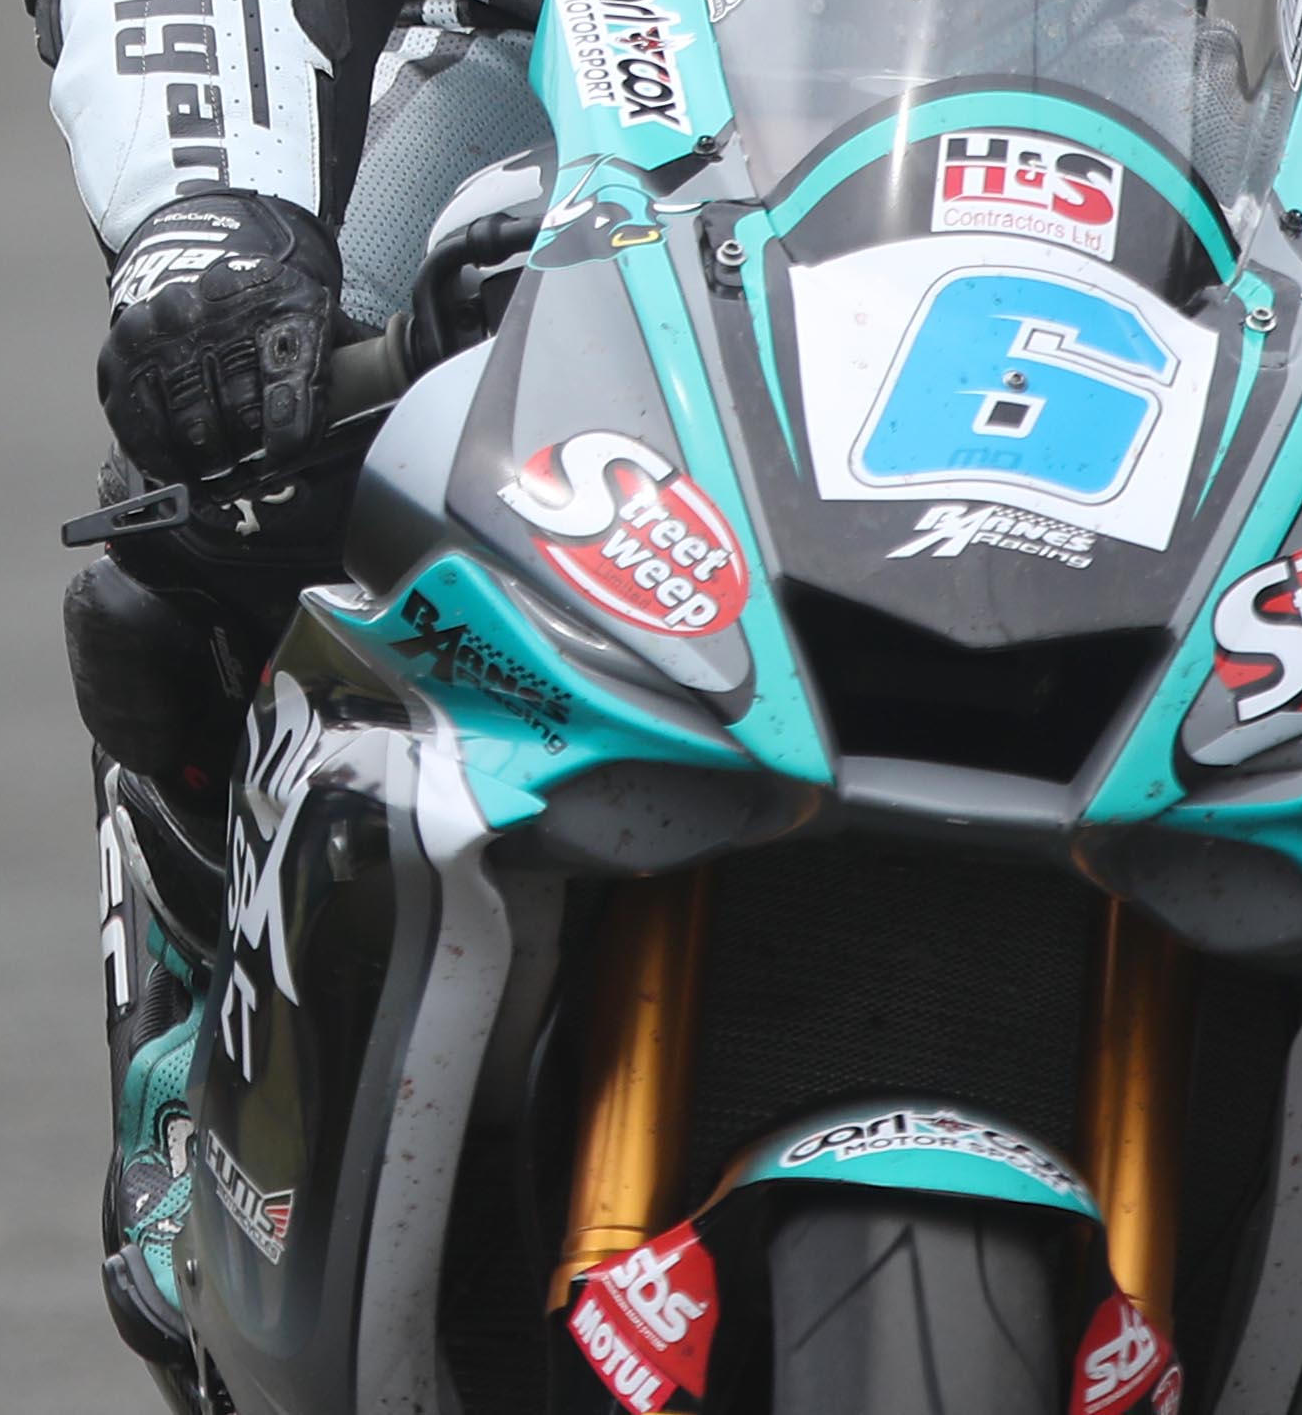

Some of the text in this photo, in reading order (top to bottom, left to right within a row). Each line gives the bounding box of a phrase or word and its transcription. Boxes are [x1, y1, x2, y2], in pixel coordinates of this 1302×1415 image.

[578, 48, 616, 104] SPORT
[941, 136, 1115, 226] H&S
[942, 206, 1068, 243] Contractors
[849, 265, 1181, 505] 6
[969, 531, 1094, 570] Racing
[842, 1135, 958, 1156] MOTOR
[610, 1247, 706, 1343] sbs
[572, 1299, 661, 1413] MOTUL
